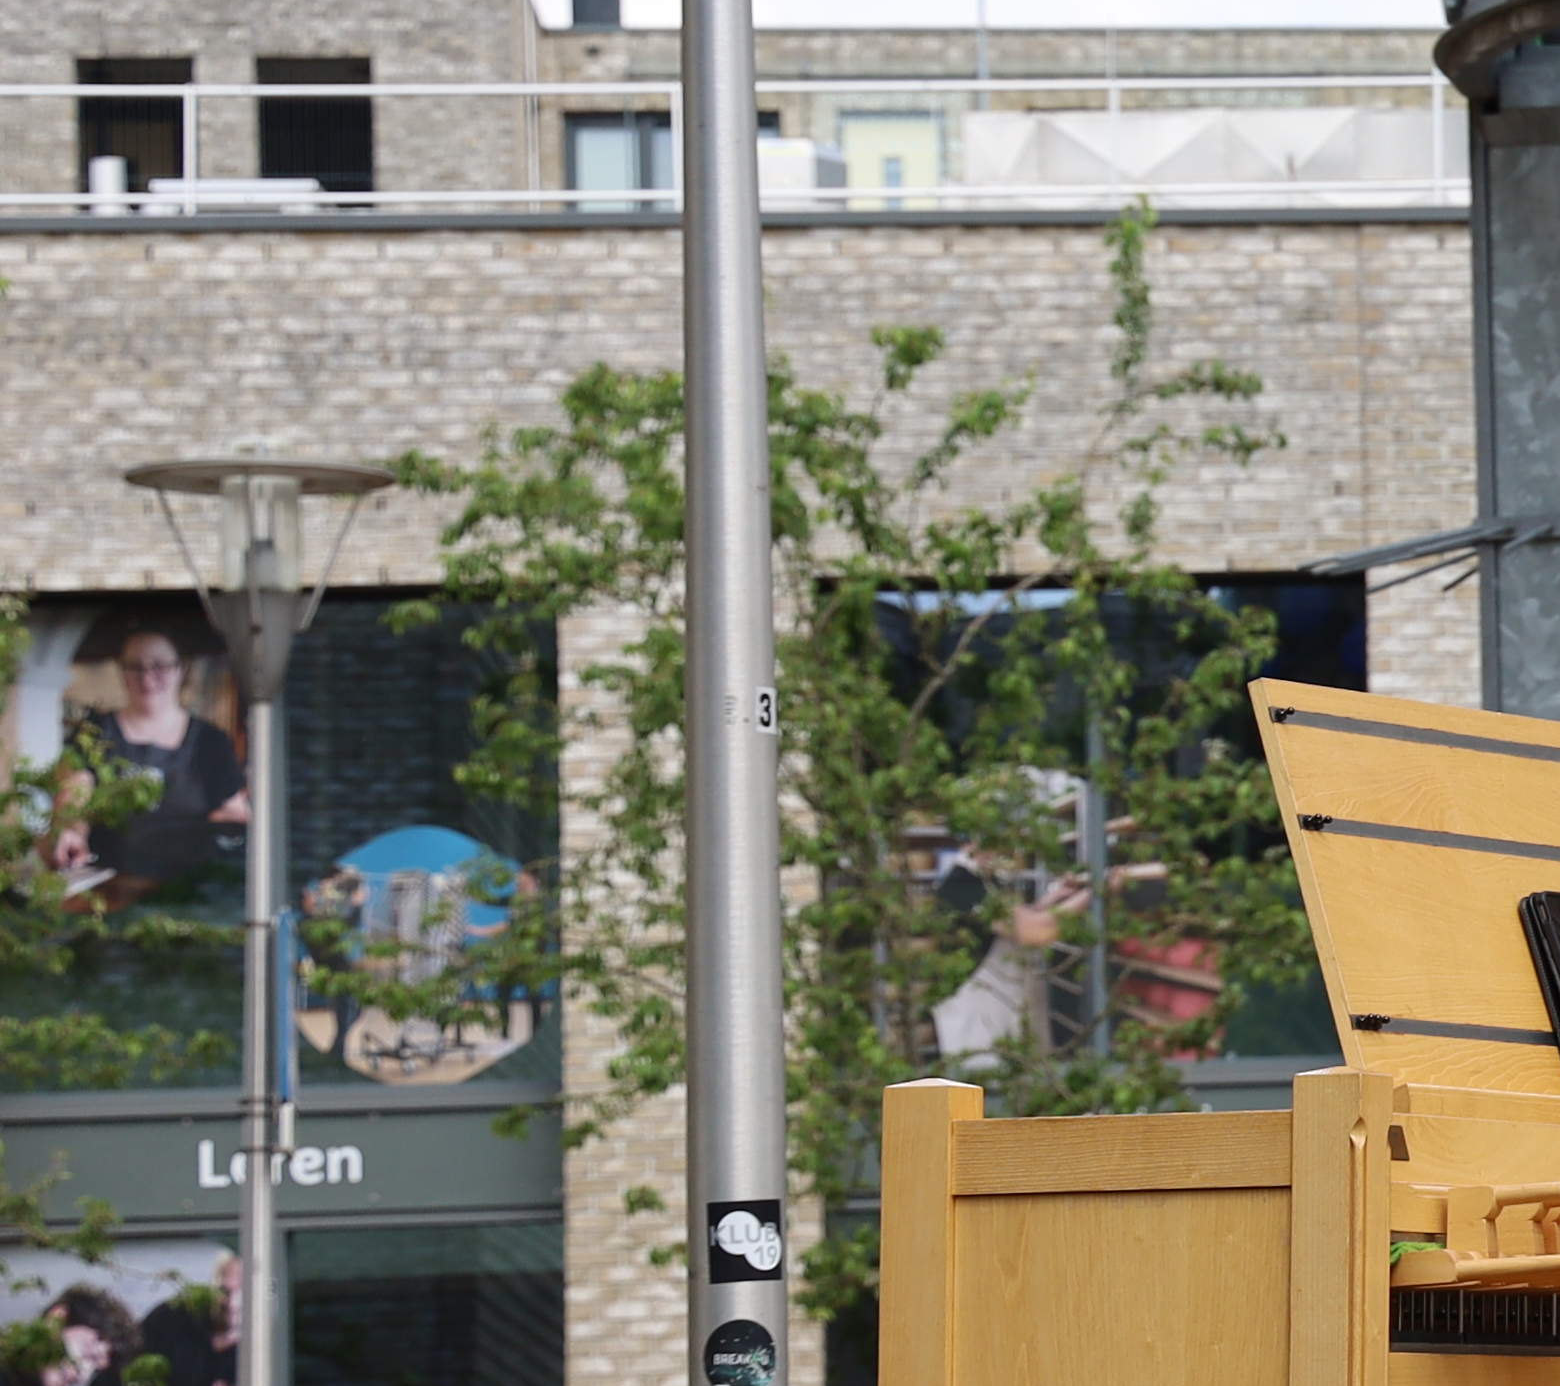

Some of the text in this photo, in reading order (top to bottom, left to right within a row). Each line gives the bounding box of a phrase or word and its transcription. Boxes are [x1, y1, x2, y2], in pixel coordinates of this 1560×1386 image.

[760, 693, 771, 727] 3
[710, 1222, 777, 1246] KLUB
[754, 1245, 777, 1265] 19
